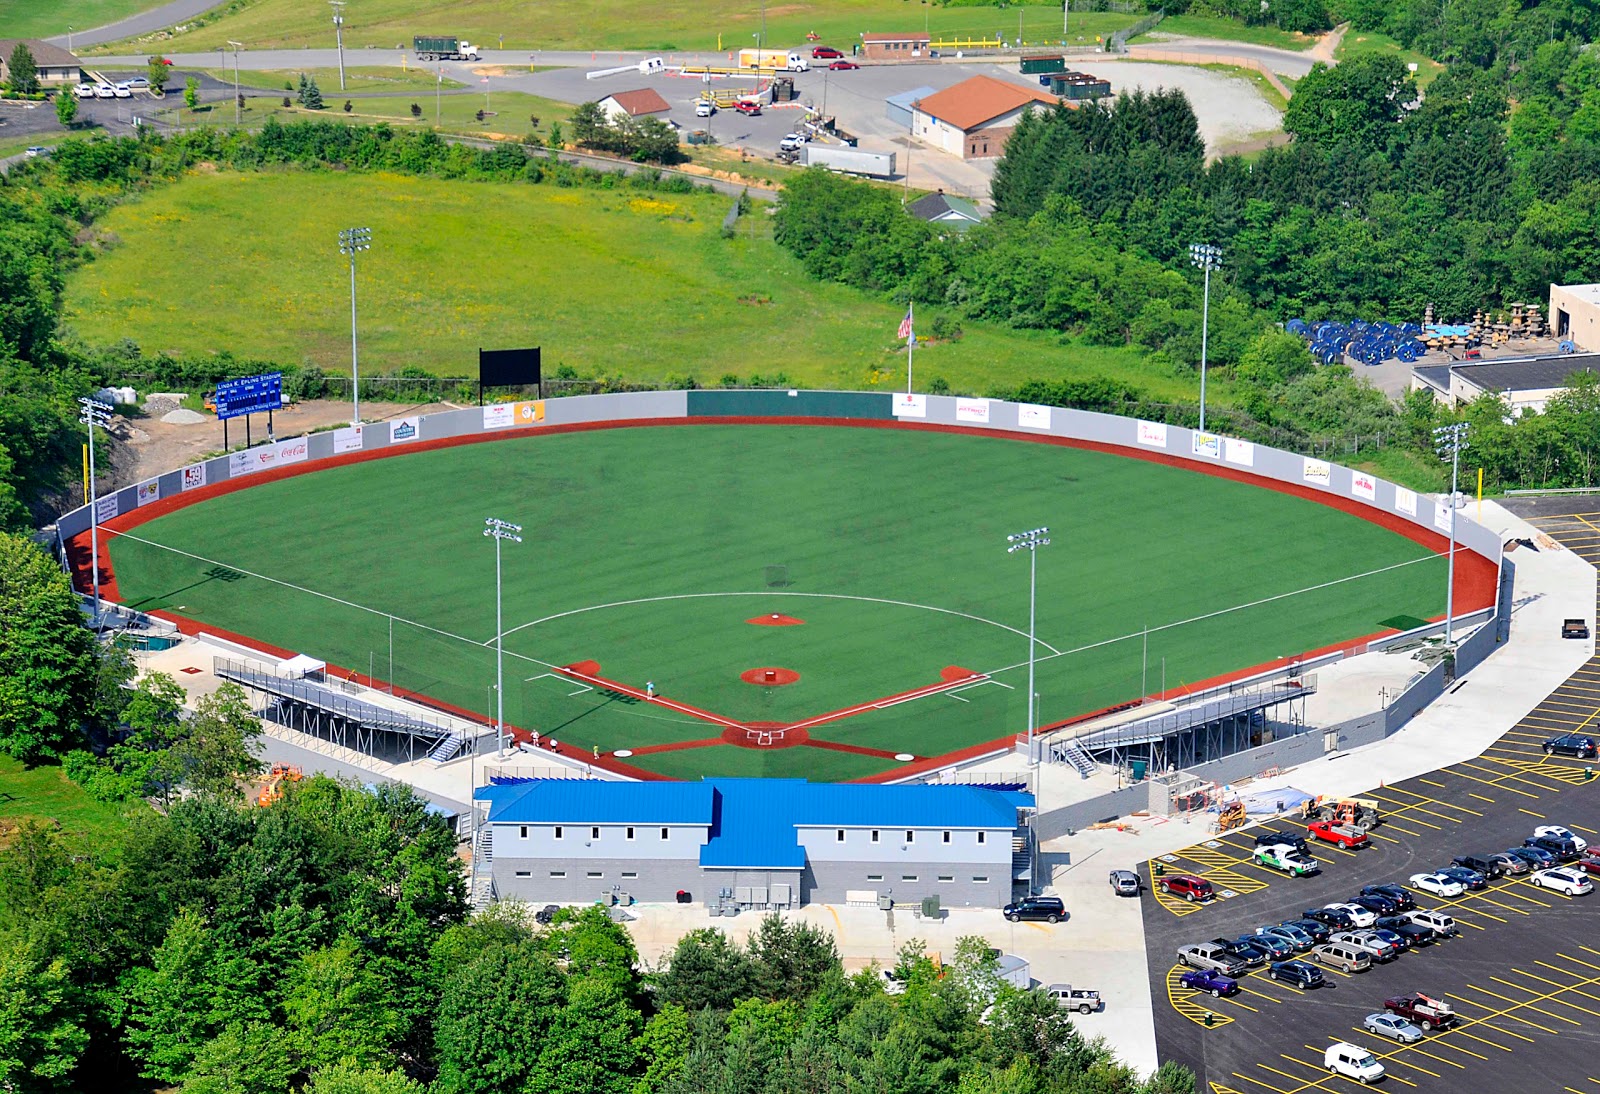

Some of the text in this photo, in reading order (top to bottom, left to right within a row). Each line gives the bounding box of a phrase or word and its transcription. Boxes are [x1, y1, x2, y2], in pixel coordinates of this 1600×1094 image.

[217, 382, 233, 390] LINDA
[240, 377, 259, 386] EPLING
[260, 373, 281, 382] STADIUM
